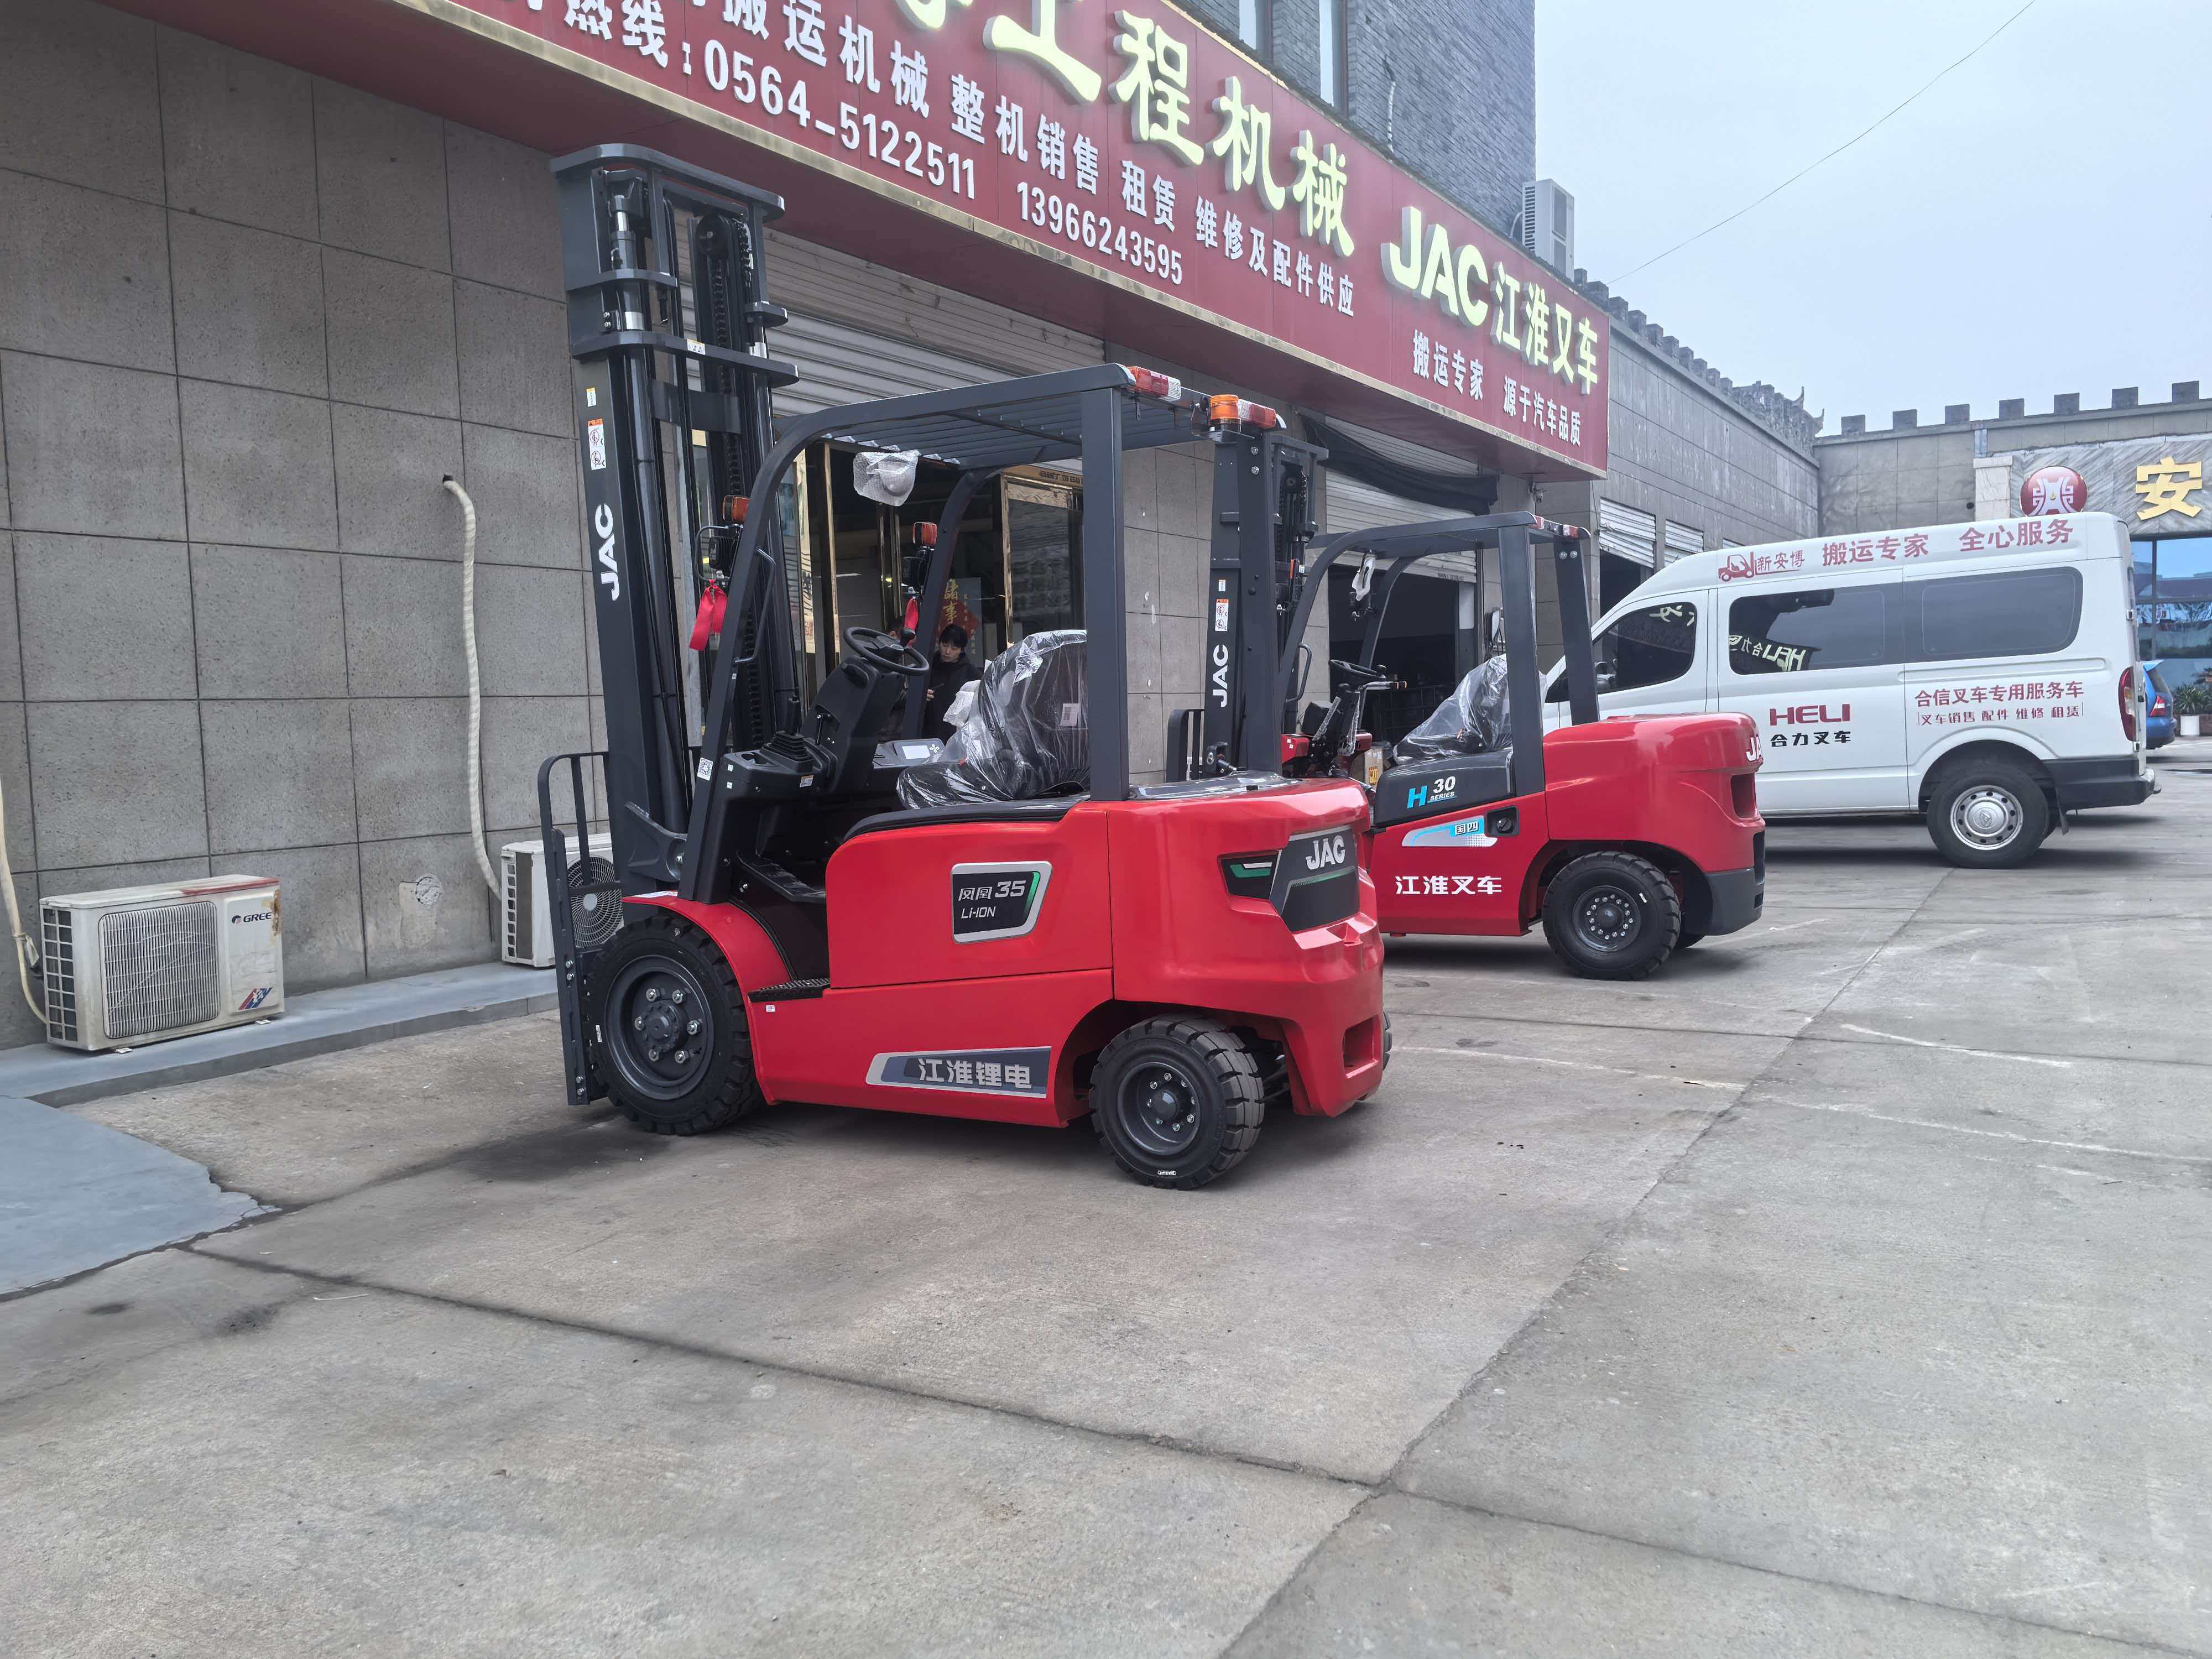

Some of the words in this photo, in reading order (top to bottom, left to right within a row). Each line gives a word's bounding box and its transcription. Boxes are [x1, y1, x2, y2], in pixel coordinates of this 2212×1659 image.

[897, 0, 1354, 257] 工程机械
[951, 74, 1099, 195] 整机销售
[1121, 160, 1175, 232] 租赁
[1195, 195, 1354, 317] 维修及配件供应
[1016, 181, 1183, 285] 13966243595
[1412, 329, 1484, 400] 搬运专家
[1503, 375, 1581, 447] 源于汽车品质
[2136, 456, 2203, 521] 安
[594, 503, 620, 601] JAC
[1822, 533, 1929, 566] 搬运专家
[1958, 519, 2074, 552] 全心服务
[1212, 644, 1229, 708] JAC
[1914, 680, 2084, 707] 合信叉车专用服务车
[1770, 703, 1850, 726] HELI
[1919, 711, 1975, 726] 叉车销售
[1981, 708, 2009, 722] 配件
[2016, 707, 2044, 720] 维修
[2051, 705, 2080, 718] 租赁
[1770, 730, 1851, 747] 合力叉车
[1407, 785, 1428, 809] H
[1433, 776, 1456, 794] 30
[1430, 791, 1454, 801] SERIES
[1305, 834, 1345, 870] JAC
[995, 879, 1027, 898] 35
[1395, 875, 1502, 895] 江淮叉车
[243, 912, 273, 923] GREE
[917, 1057, 1032, 1089] 江淮锂电
